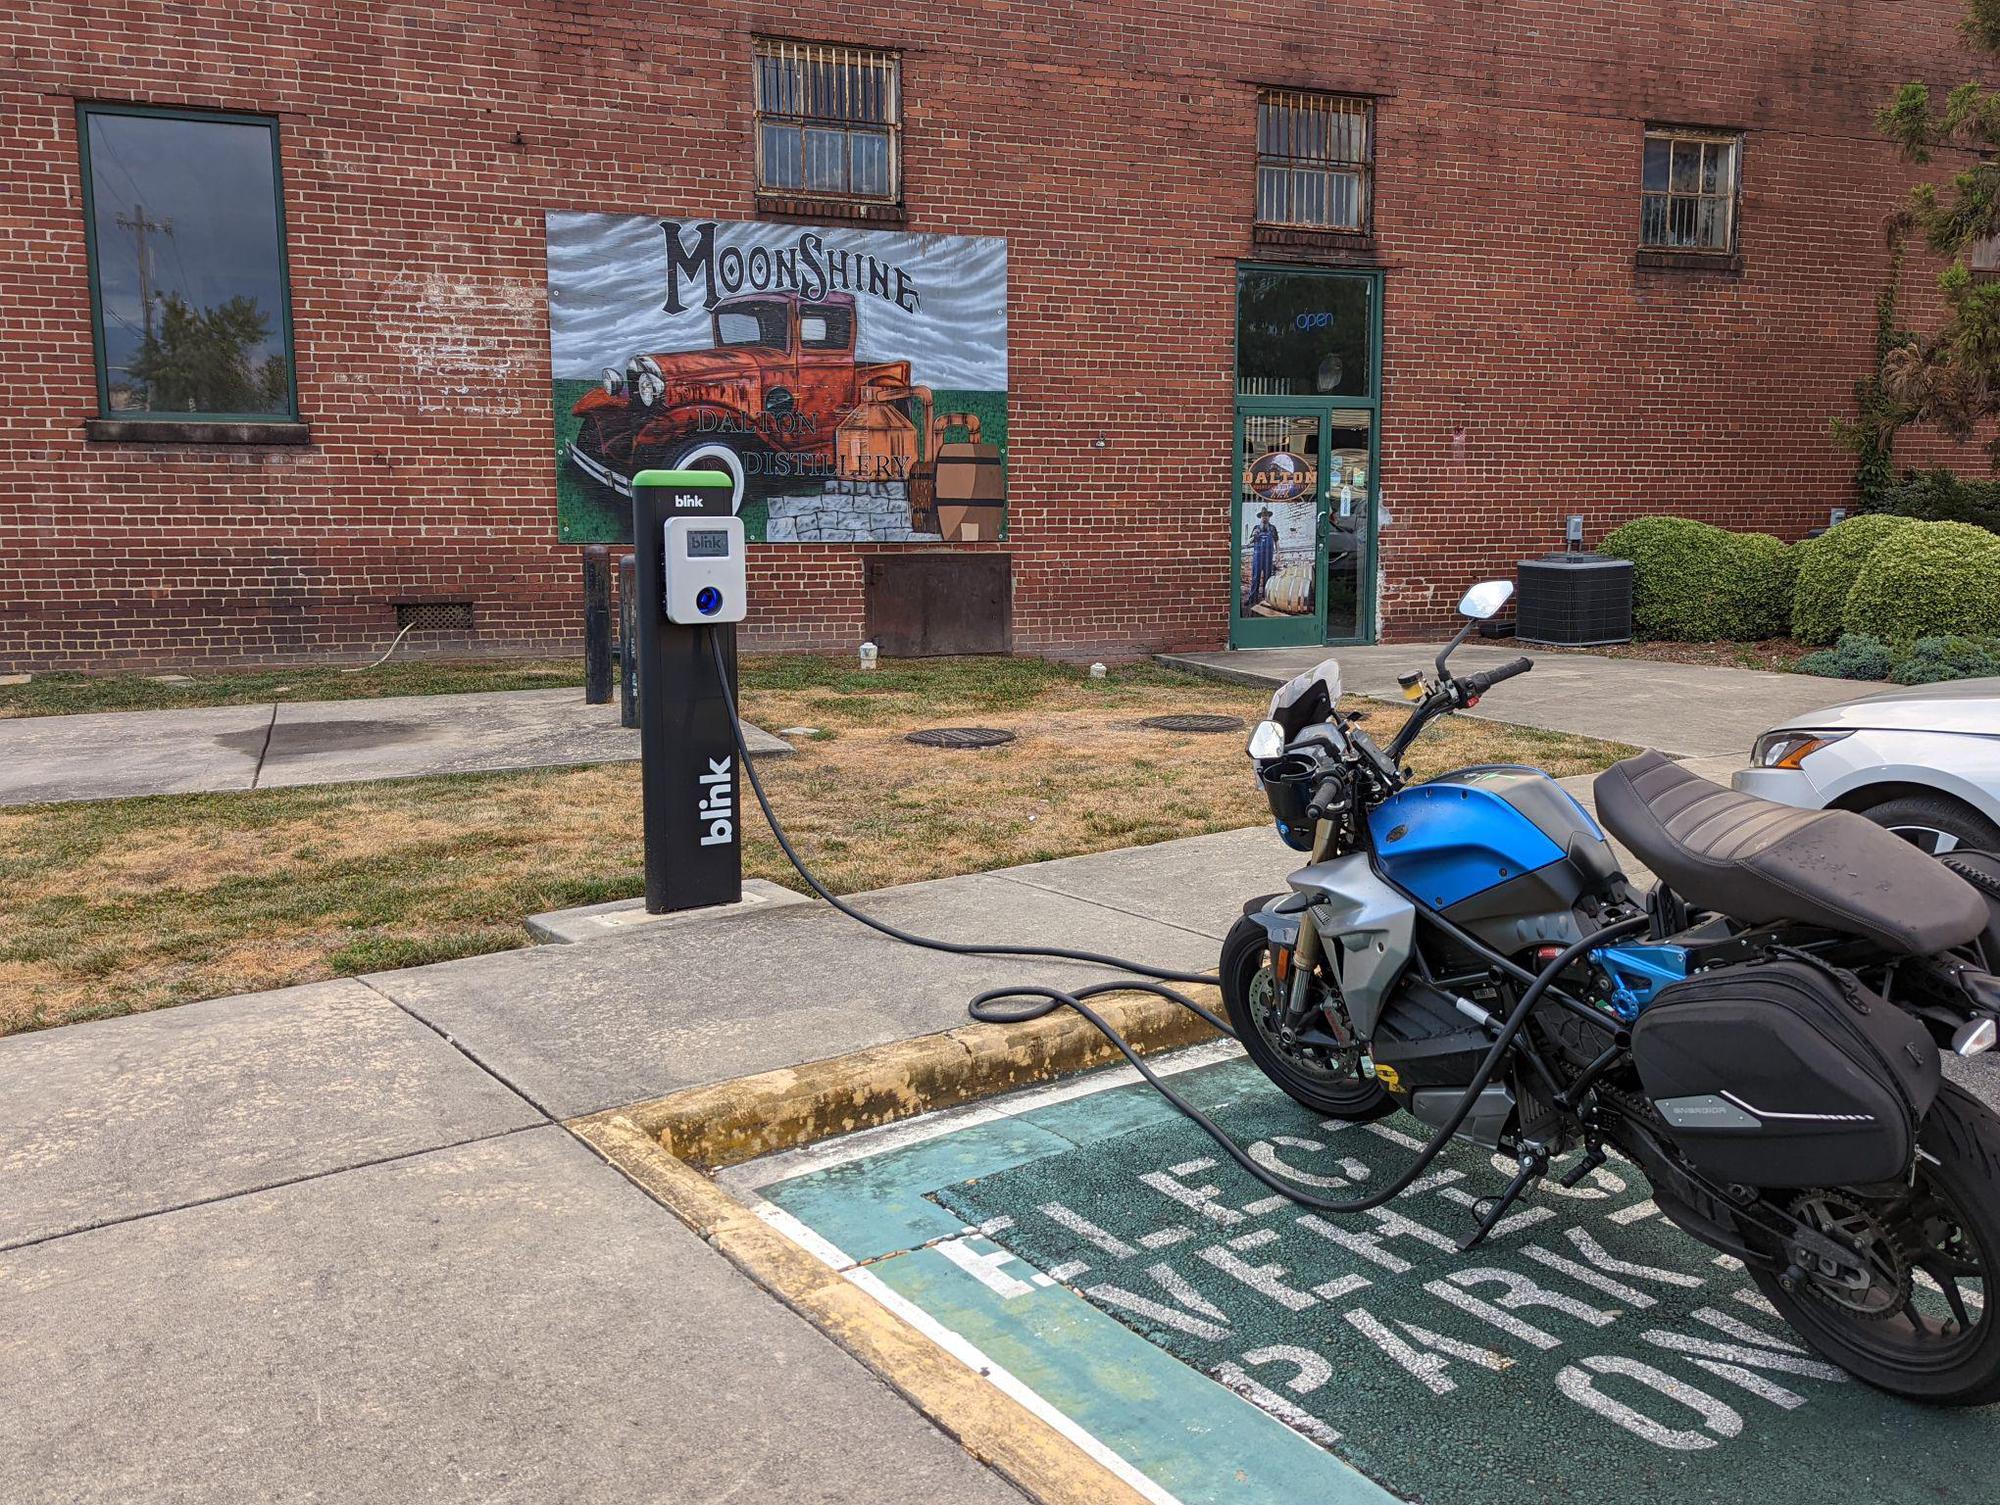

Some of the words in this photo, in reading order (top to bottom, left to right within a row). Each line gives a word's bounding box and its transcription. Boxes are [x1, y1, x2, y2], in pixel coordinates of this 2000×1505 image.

[696, 409, 818, 435] DALTON
[742, 451, 911, 479] DISTILLERY
[1242, 471, 1317, 484] DALTON
[674, 494, 704, 508] blink
[691, 535, 721, 549] blink
[699, 754, 733, 846] blink
[933, 1117, 1446, 1300] ELECT
[1085, 1143, 1632, 1341] VEHIC
[1208, 1199, 1745, 1446] PARK
